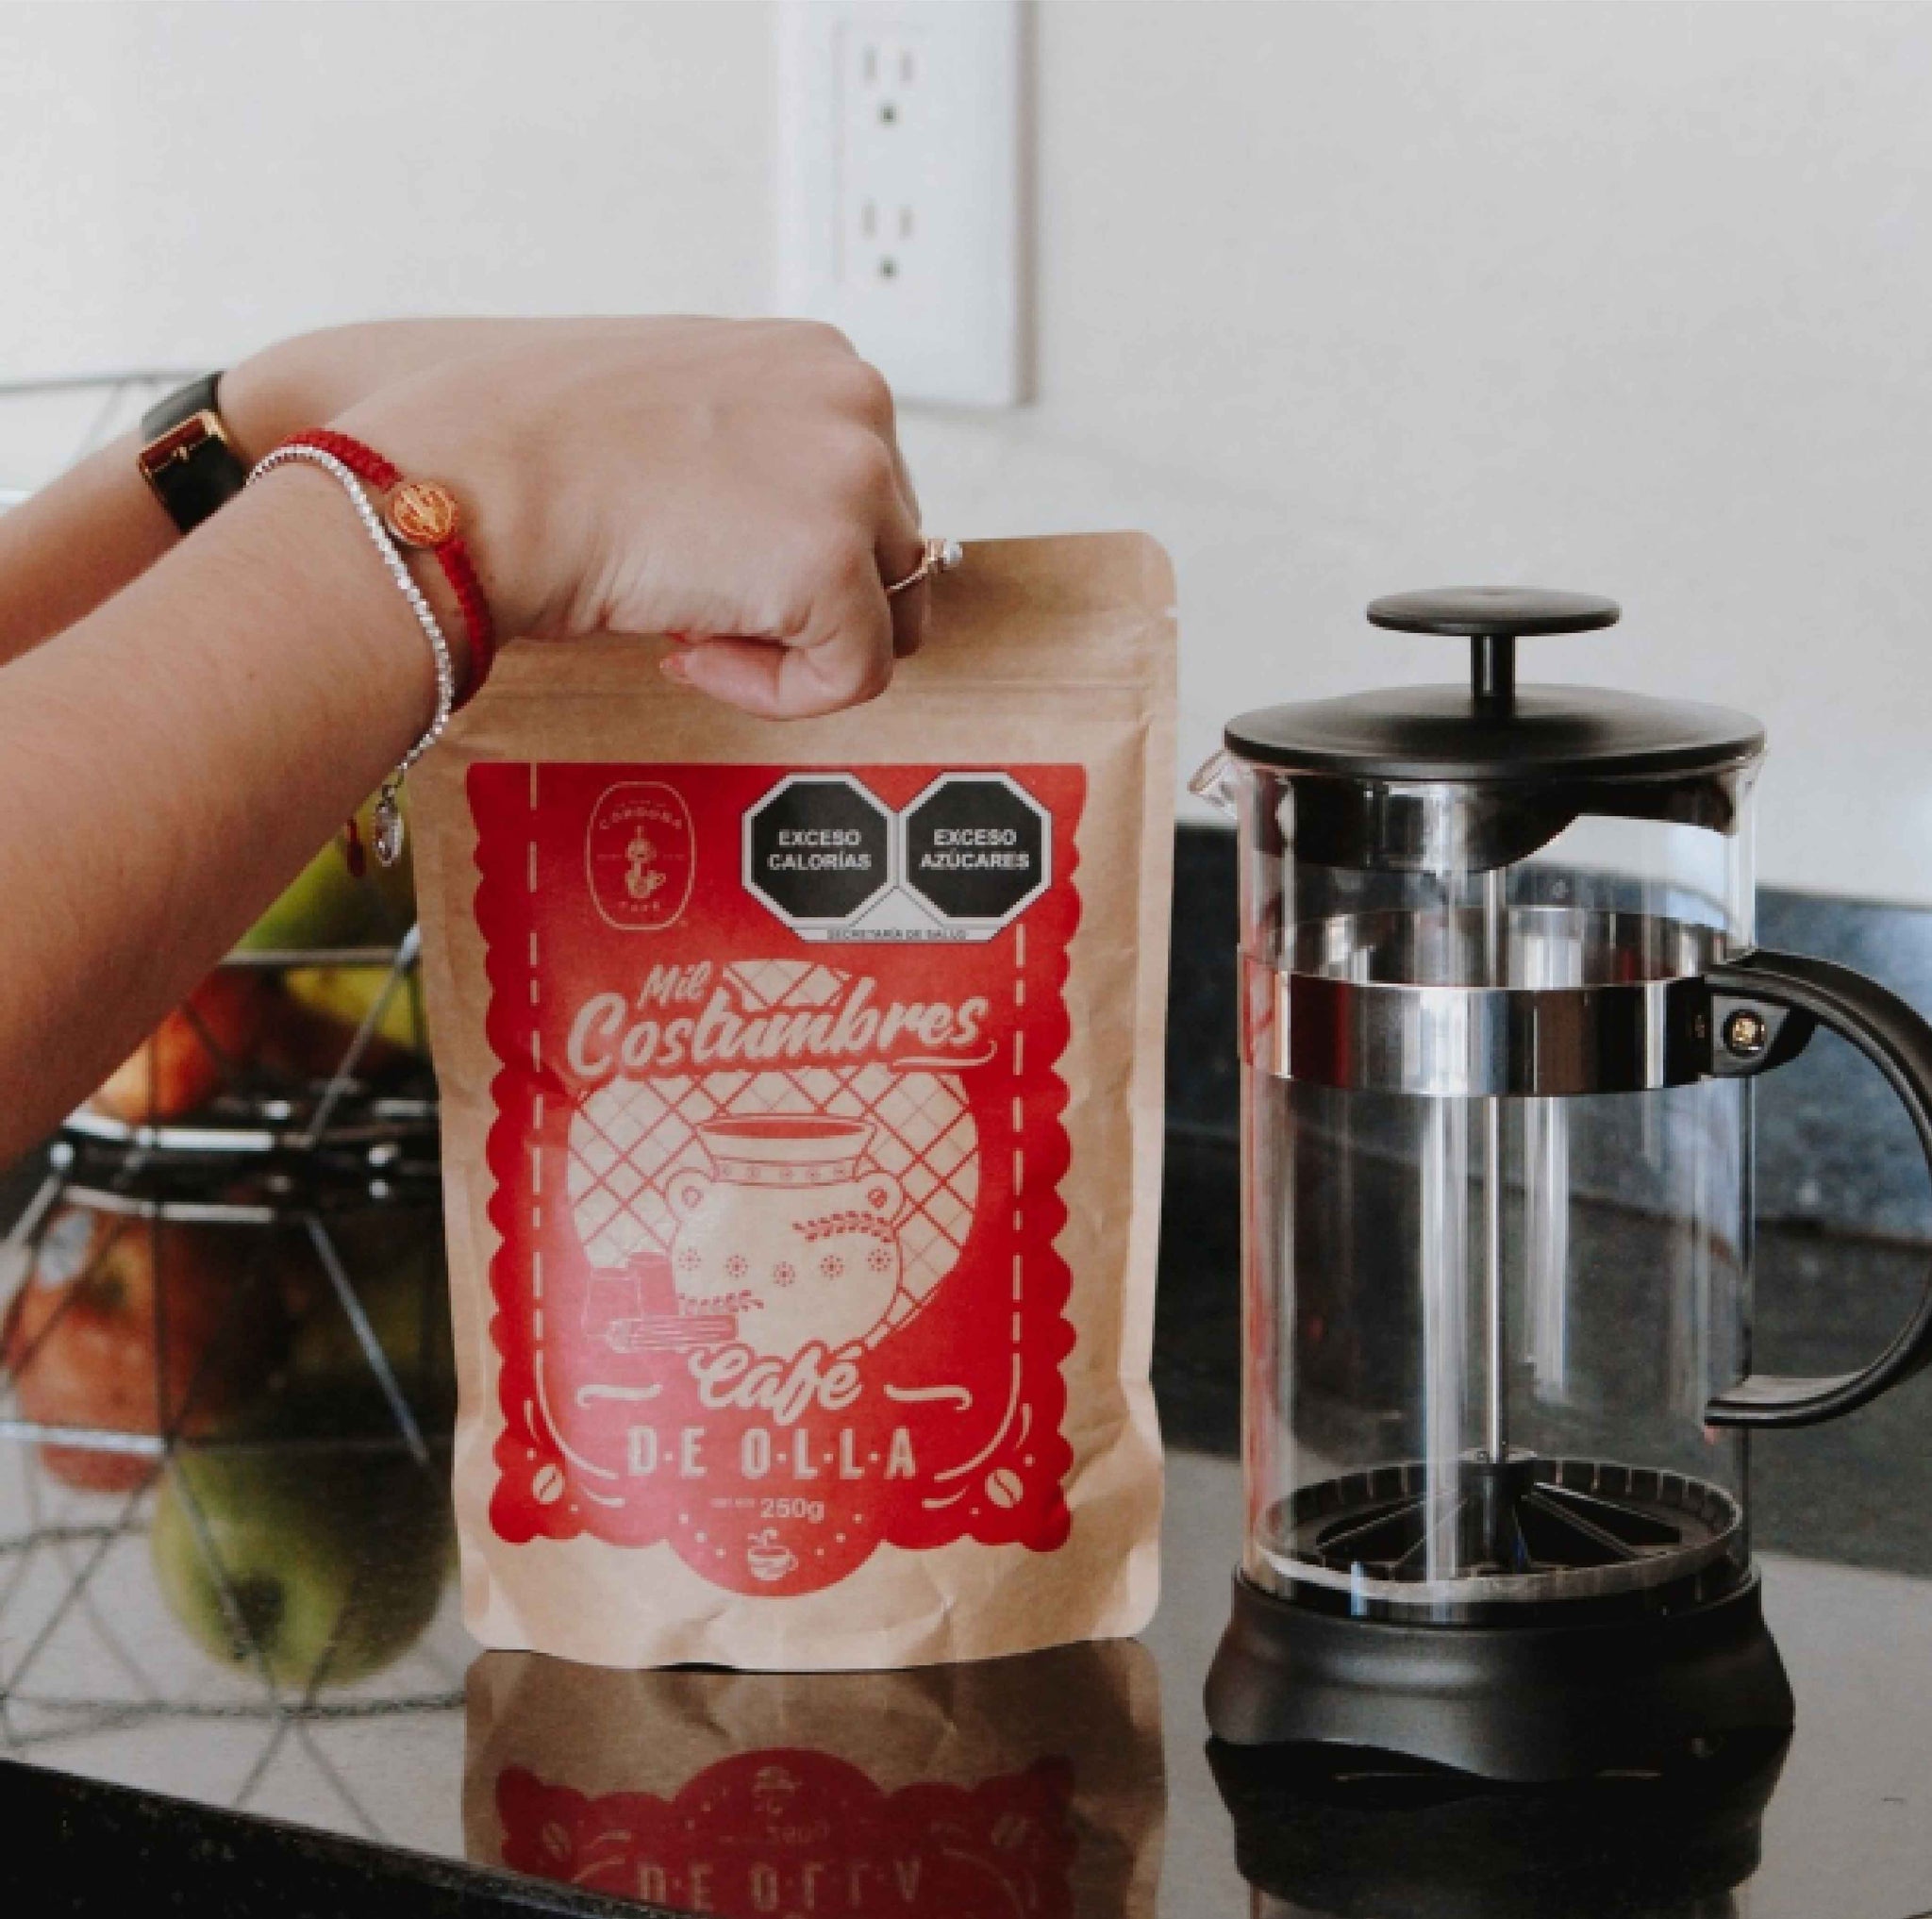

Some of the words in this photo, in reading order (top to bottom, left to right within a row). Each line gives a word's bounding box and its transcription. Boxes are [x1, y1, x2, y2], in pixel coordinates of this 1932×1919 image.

[778, 828, 861, 846] EXCESO
[934, 828, 1017, 846] EXCESO
[767, 849, 872, 870] CALORÍAS
[919, 849, 1030, 870] AZÚCARES
[638, 960, 711, 1010] Mil
[566, 976, 989, 1076] Costumbres
[689, 1340, 862, 1426] Café
[759, 1497, 825, 1524] 250g
